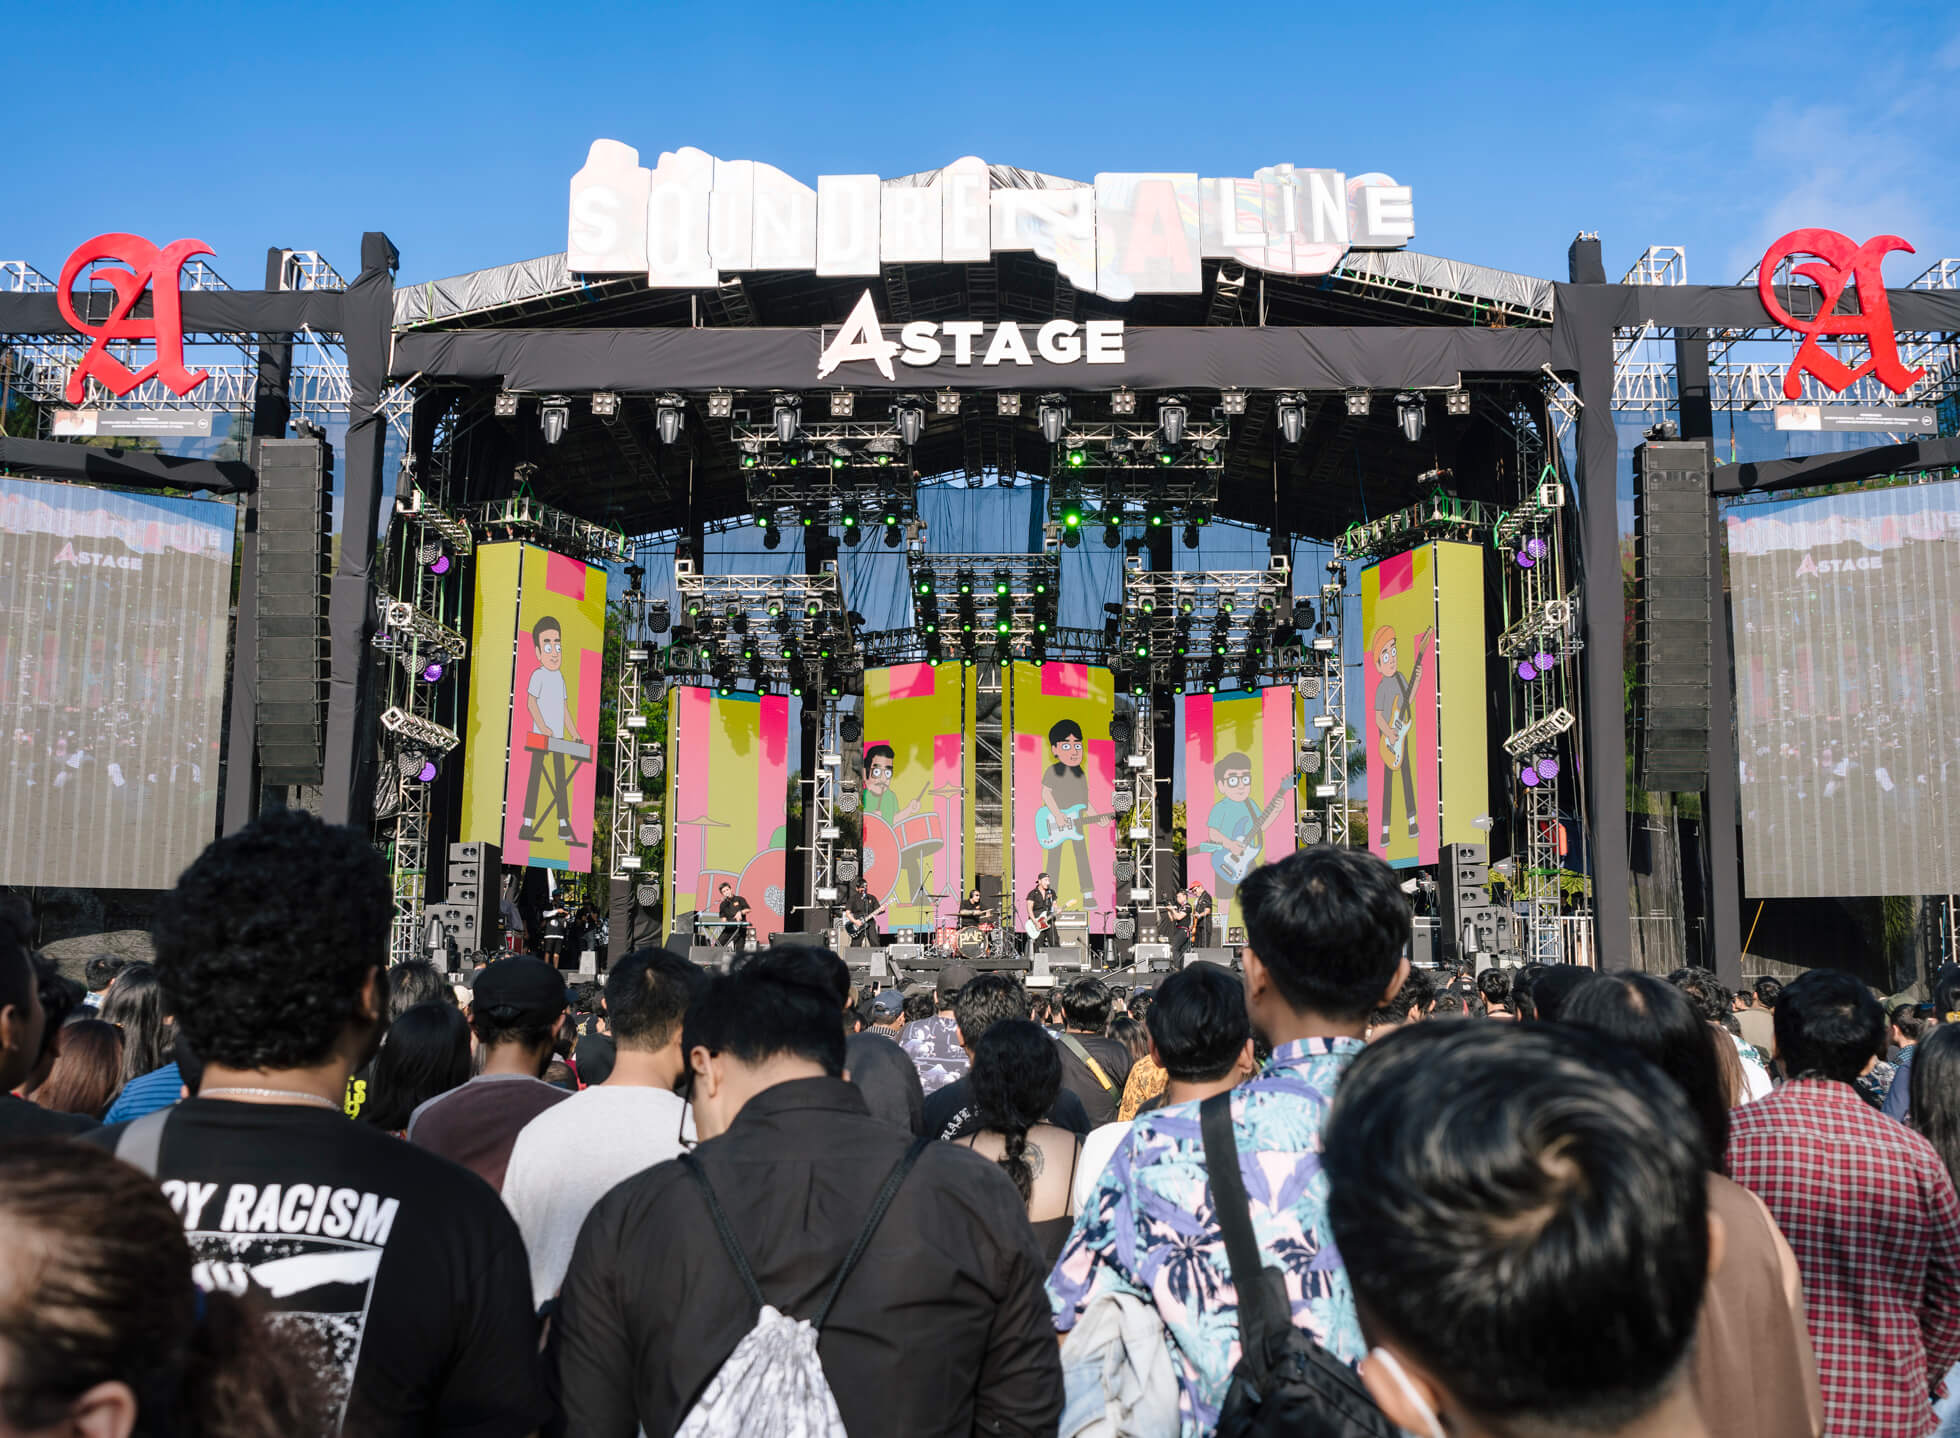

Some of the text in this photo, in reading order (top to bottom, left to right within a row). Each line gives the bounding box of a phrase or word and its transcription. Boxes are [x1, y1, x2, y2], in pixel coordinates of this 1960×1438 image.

[57, 232, 217, 405] A
[1759, 228, 1926, 399] A
[219, 1183, 400, 1246] RACISM
